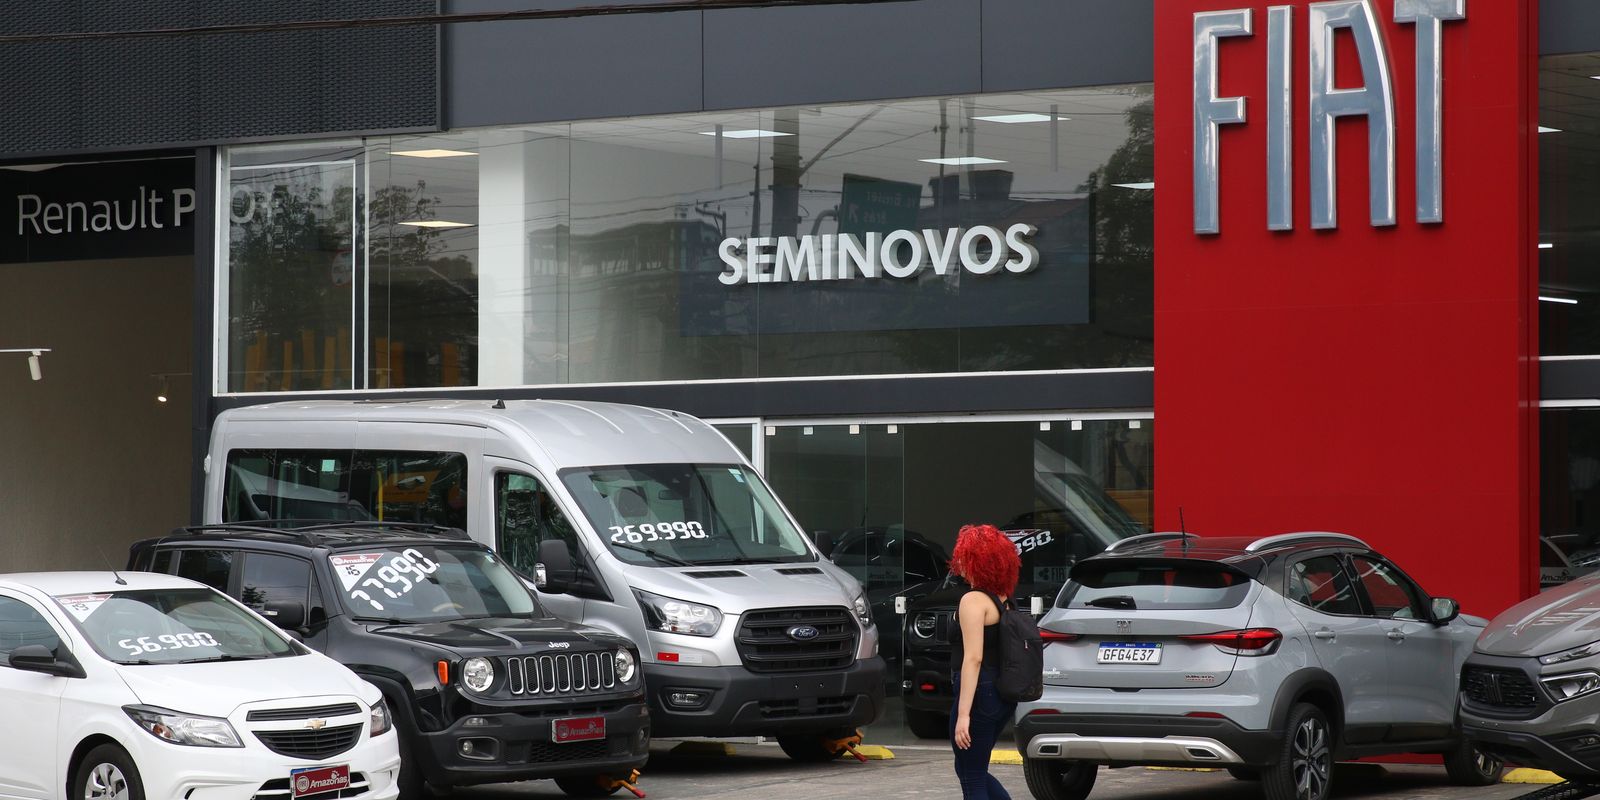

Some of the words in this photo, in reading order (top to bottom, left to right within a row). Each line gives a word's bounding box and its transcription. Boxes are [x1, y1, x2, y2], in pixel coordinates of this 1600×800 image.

[1193, 0, 1466, 234] FIAT
[17, 186, 163, 236] Renault
[718, 223, 1040, 286] SEMINOVOS
[548, 641, 570, 649] Jeep
[1103, 648, 1155, 662] GFG4E37
[309, 774, 348, 789] Amazonas
